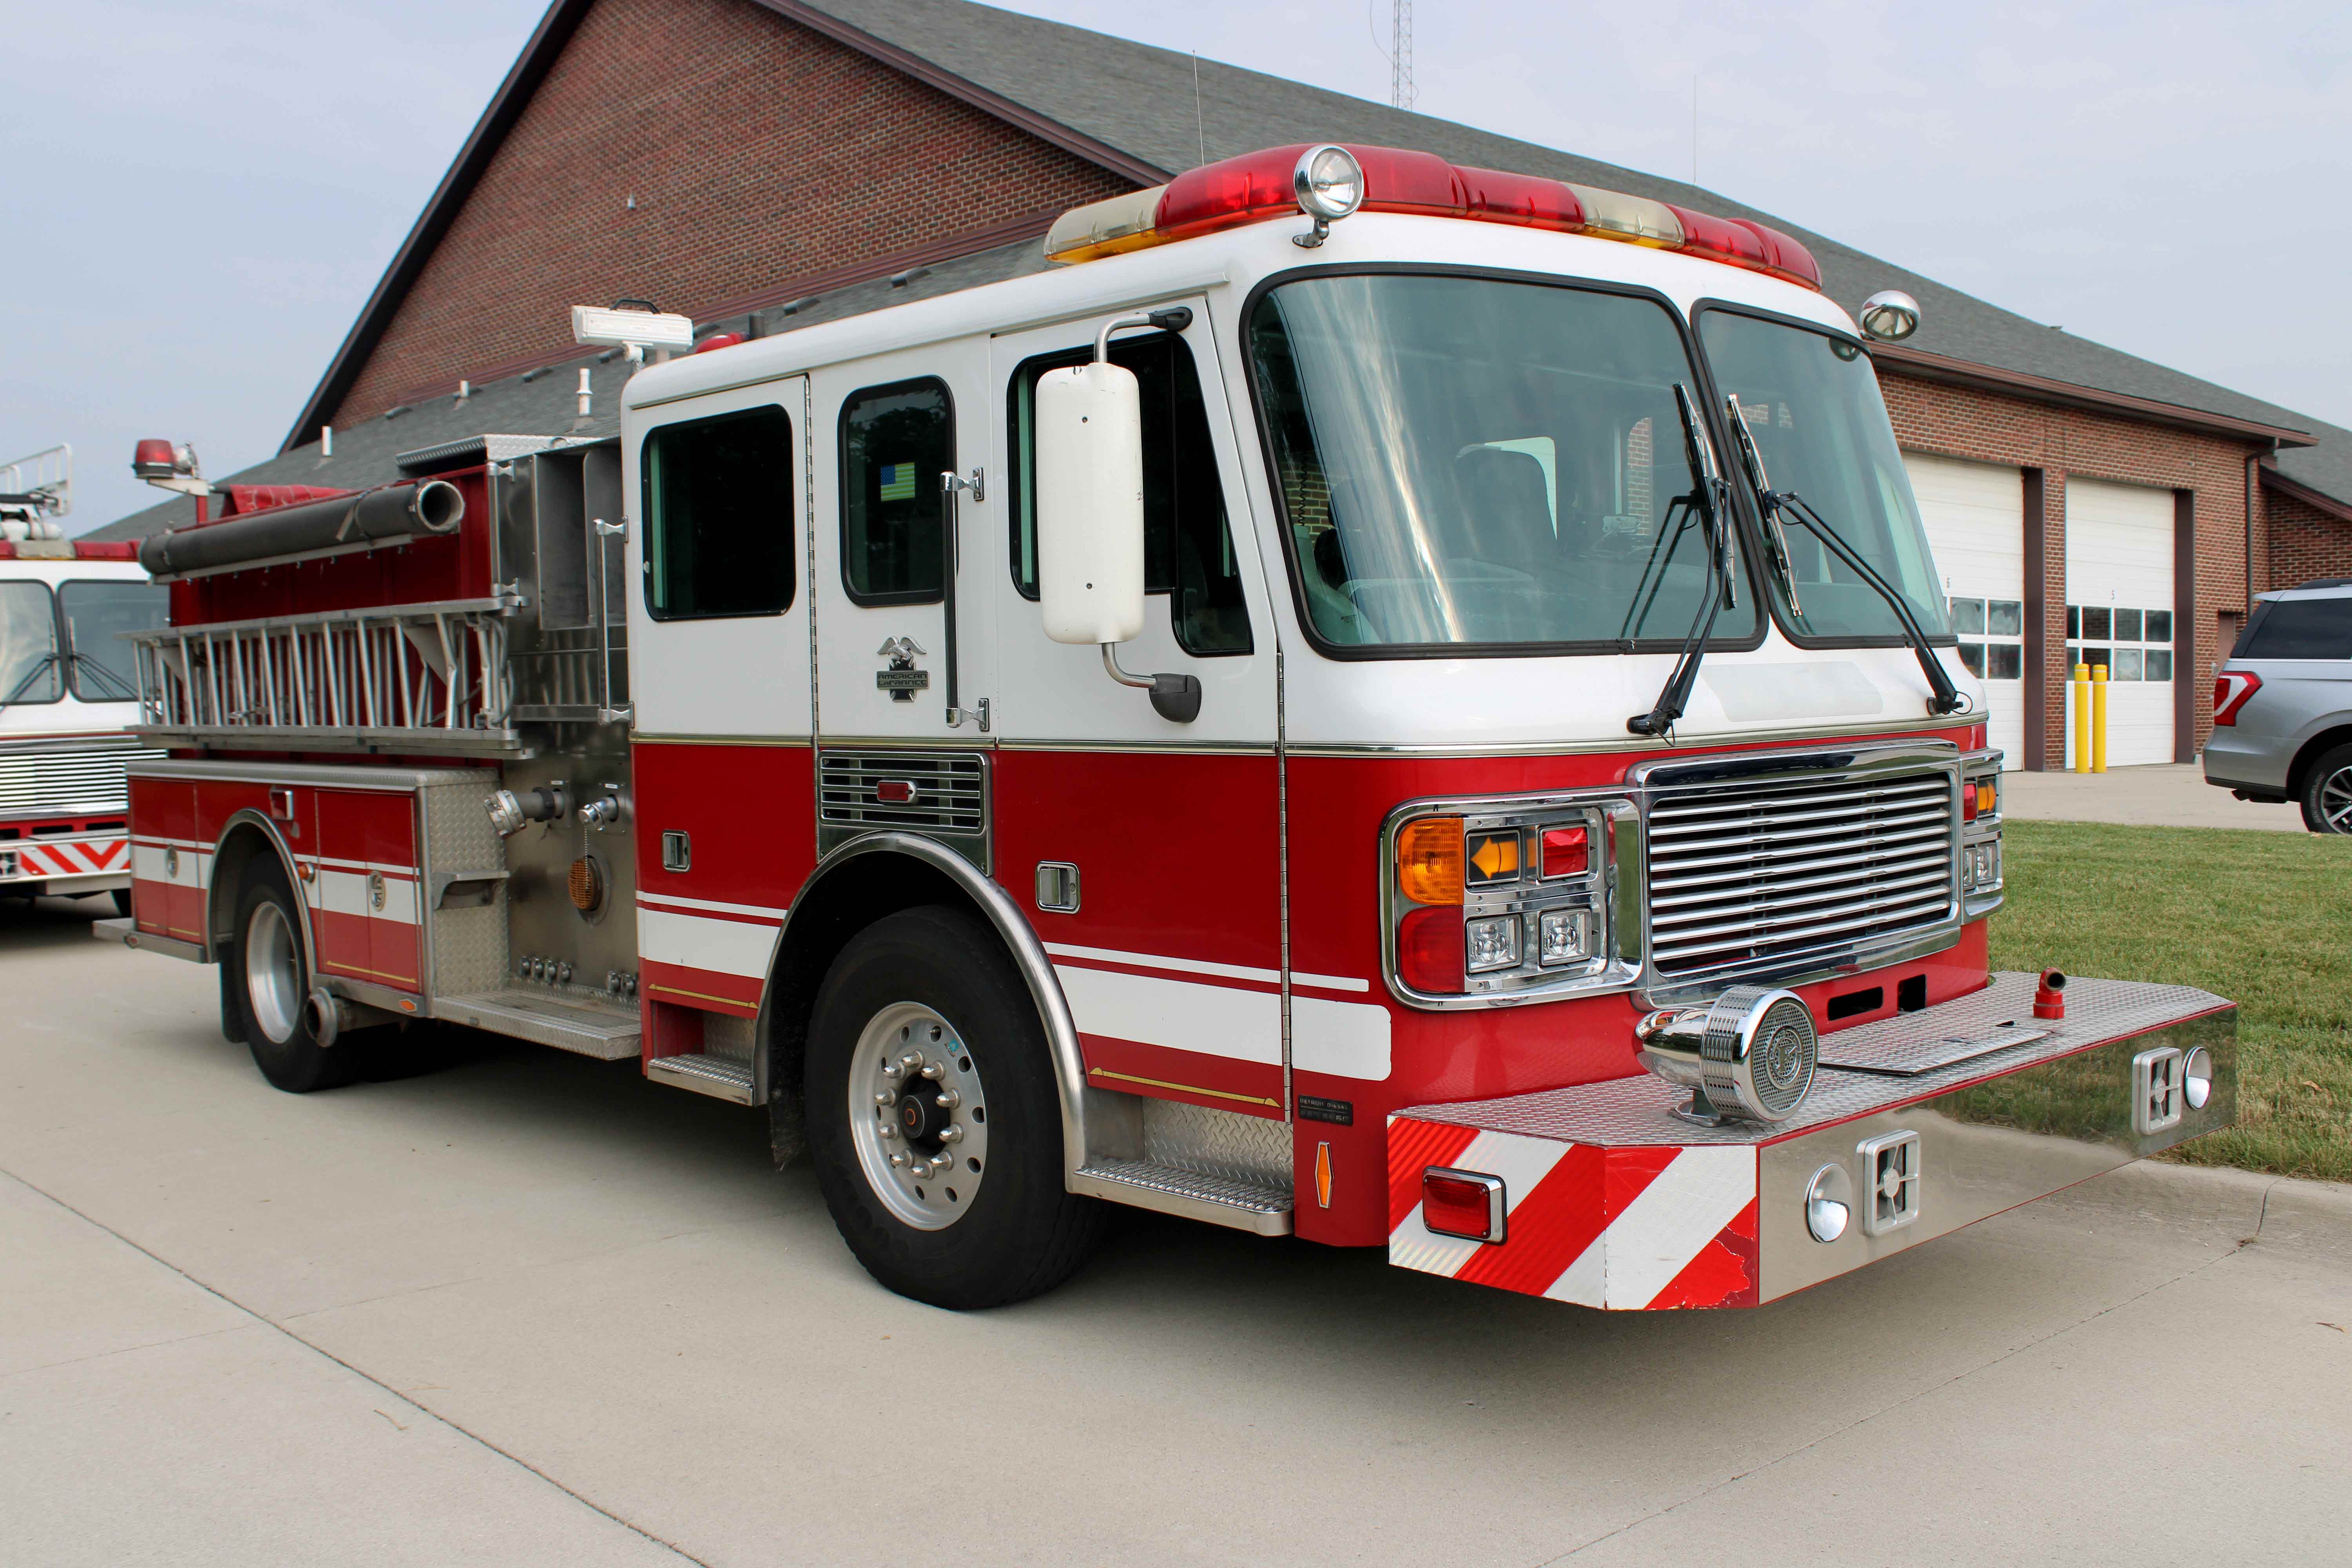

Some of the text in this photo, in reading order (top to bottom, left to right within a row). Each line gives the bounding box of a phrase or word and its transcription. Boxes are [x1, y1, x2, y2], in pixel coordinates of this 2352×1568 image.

[1946, 577, 1950, 589] 6
[2111, 590, 2115, 600] 5
[944, 1043, 955, 1058] ALCOA
[1327, 1102, 1349, 1111] DIESEL
